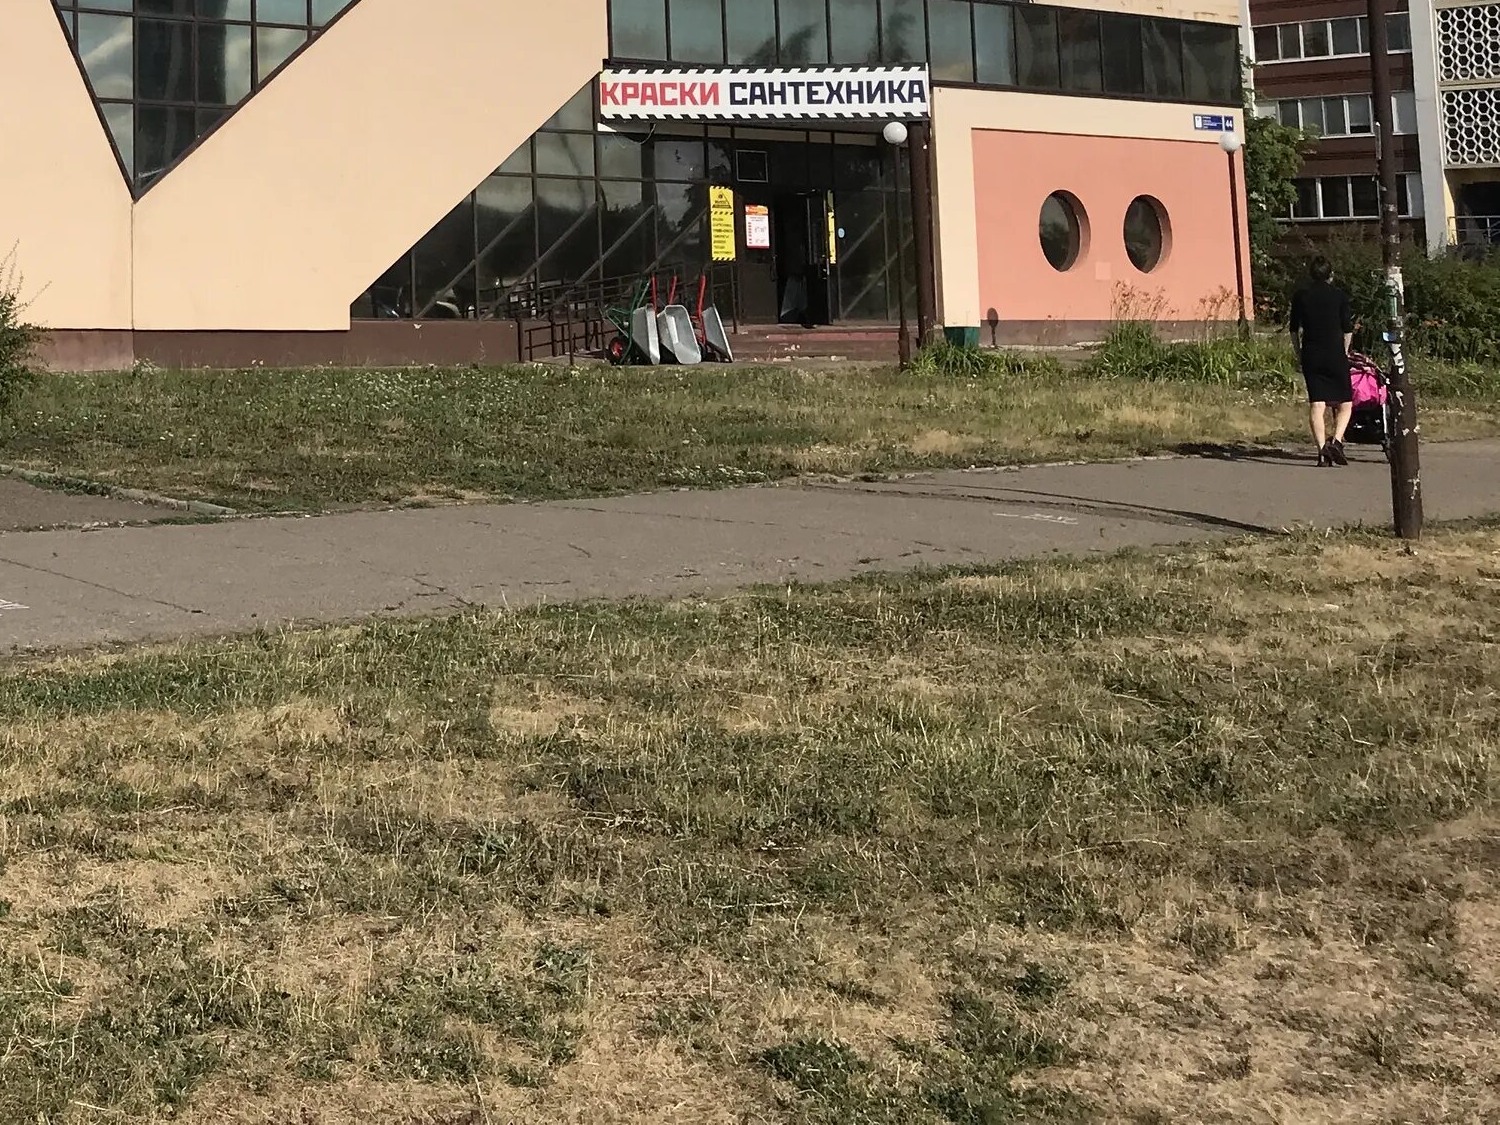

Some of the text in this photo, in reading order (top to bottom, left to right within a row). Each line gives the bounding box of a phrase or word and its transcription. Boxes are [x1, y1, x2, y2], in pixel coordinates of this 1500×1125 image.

[600, 79, 927, 107] КРАСКИ САНТЕХНИКА
[1225, 119, 1233, 128] 44
